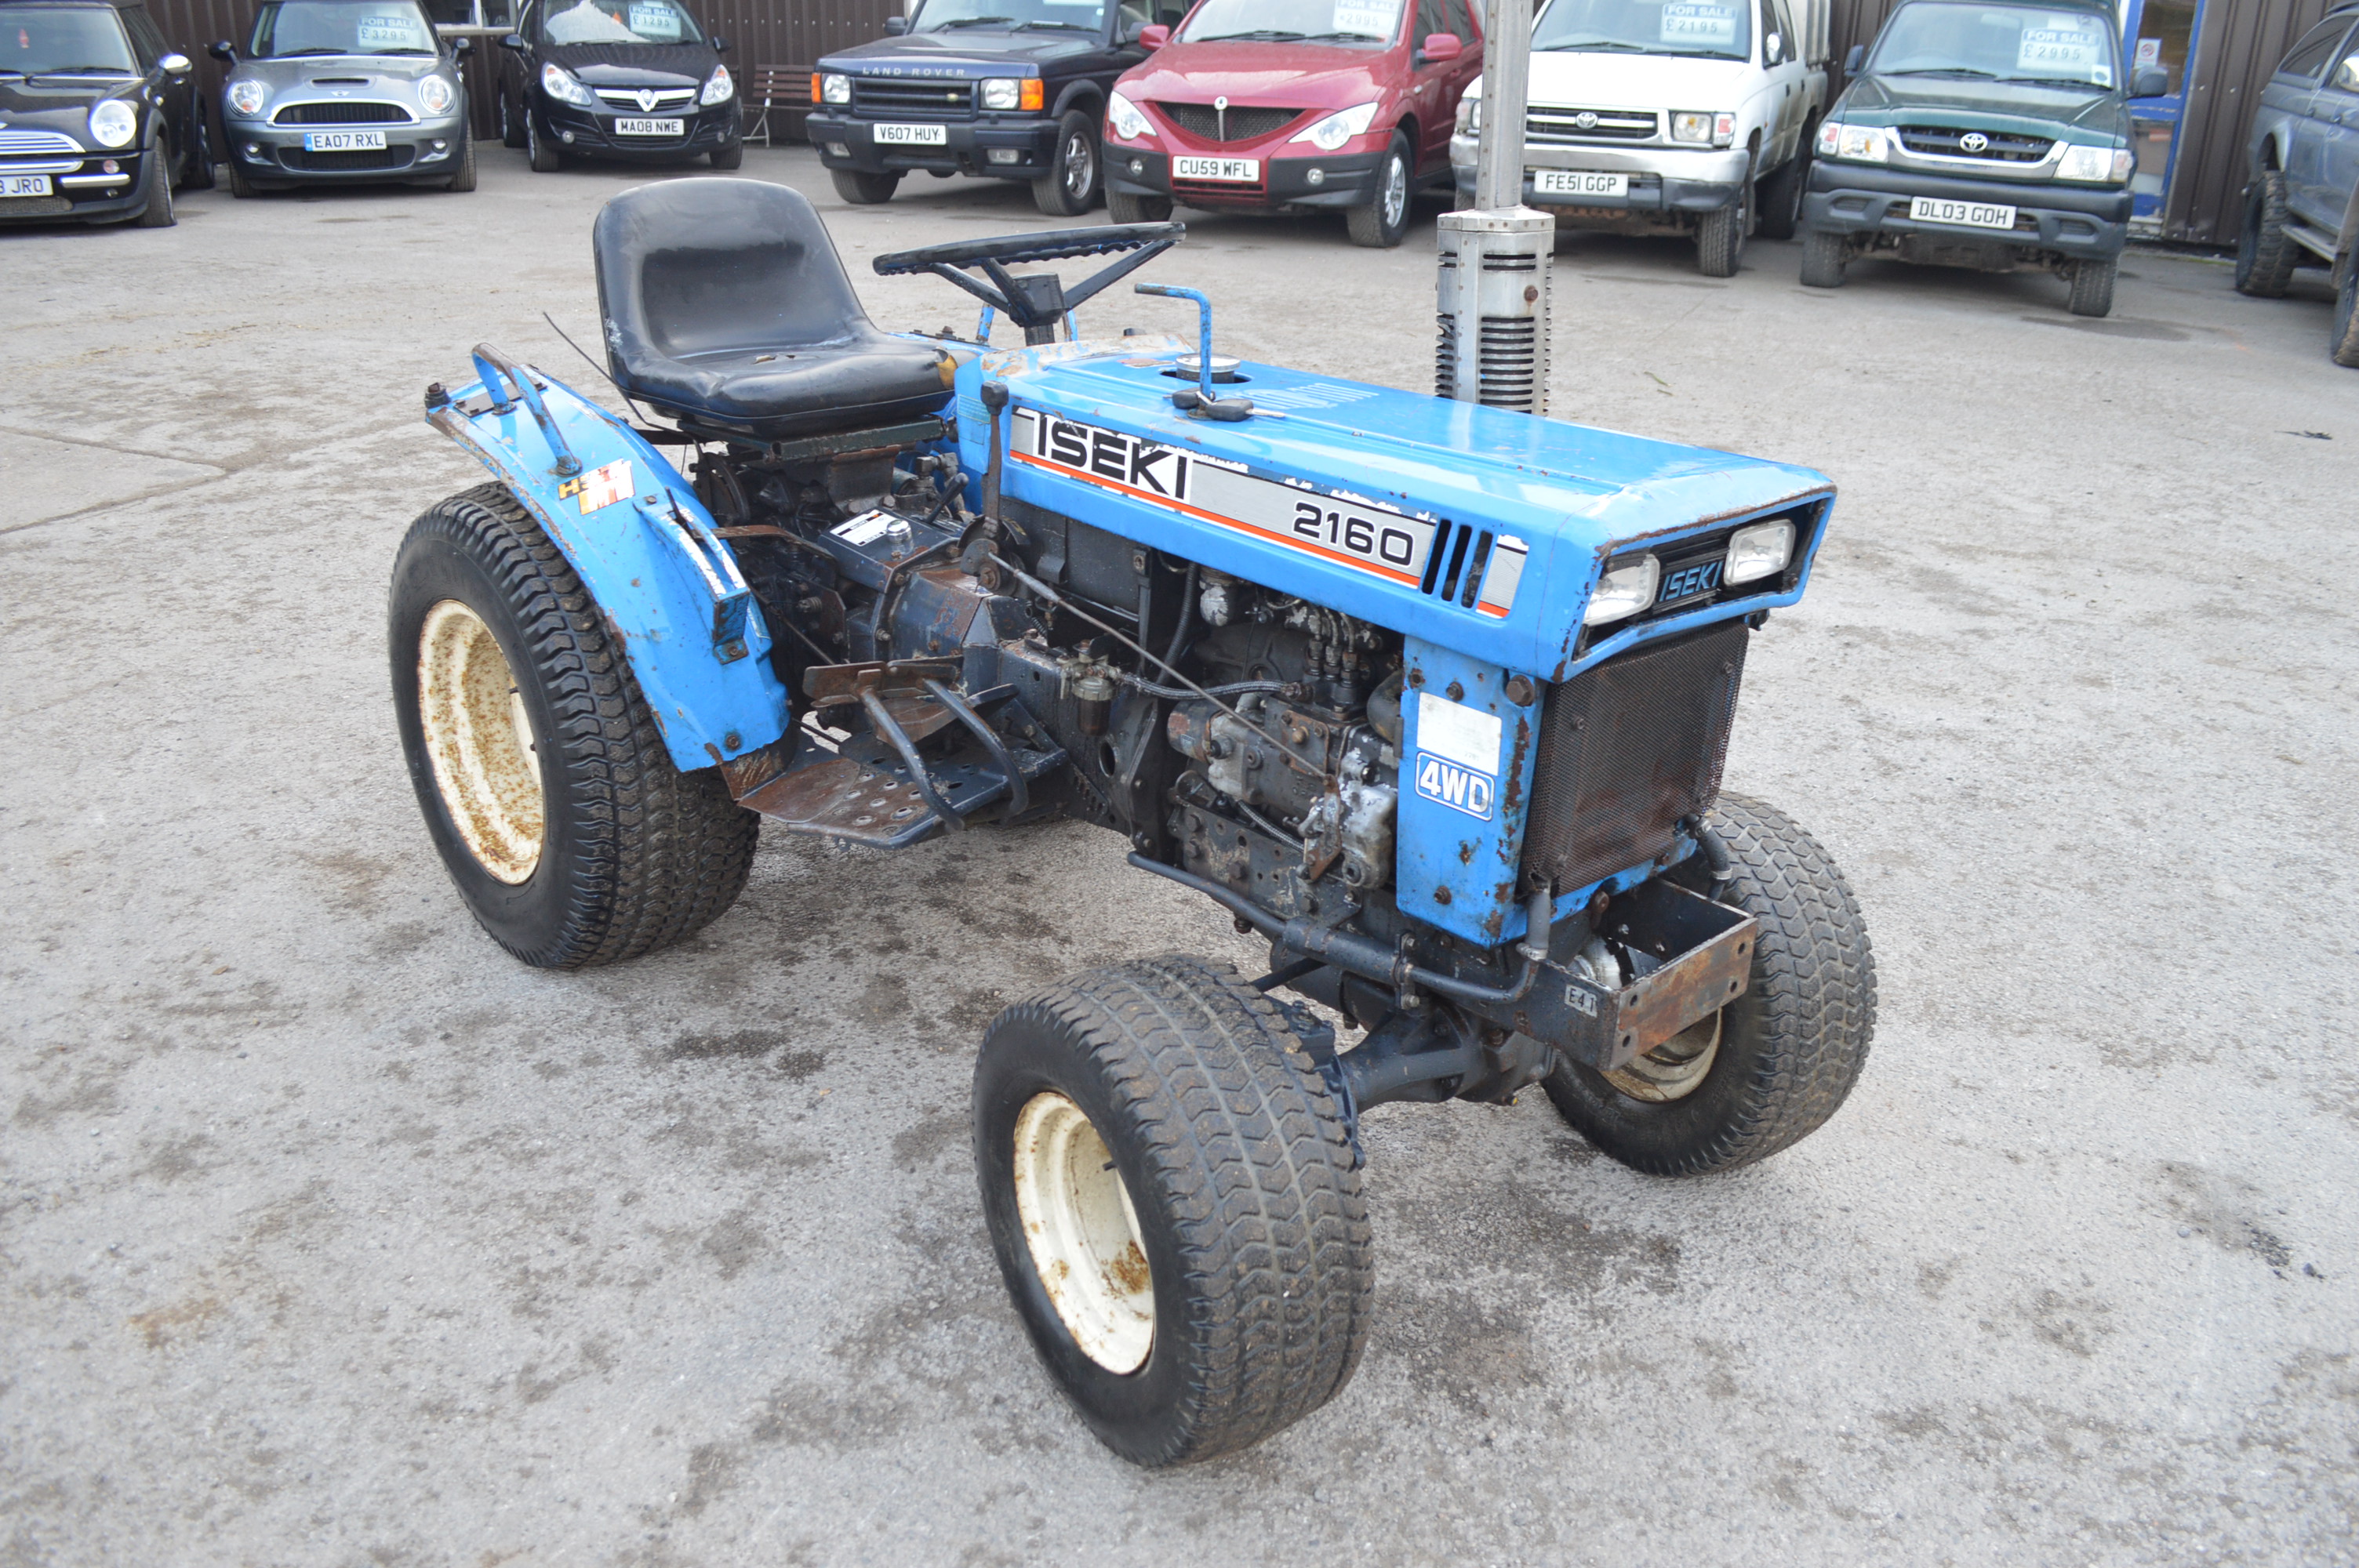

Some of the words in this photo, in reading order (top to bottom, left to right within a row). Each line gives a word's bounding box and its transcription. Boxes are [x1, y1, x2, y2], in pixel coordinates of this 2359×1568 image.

[633, 5, 652, 14] FOR
[653, 8, 677, 16] SALE
[1668, 5, 1696, 16] FOR
[1699, 6, 1732, 18] SALE
[362, 17, 385, 27] FOR
[2026, 31, 2057, 42] FOR
[2059, 32, 2095, 45] SALE
[863, 67, 902, 76] LAND
[911, 67, 965, 77] ROVER
[620, 121, 652, 132] MA08
[656, 121, 678, 132] NWE
[880, 125, 911, 140] V607
[914, 127, 940, 141] HUY
[314, 134, 351, 148] EA07
[355, 133, 383, 147] RXL
[1180, 159, 1219, 176] CU59
[1223, 161, 1252, 177] WFL
[11, 178, 45, 194] JRO
[1546, 174, 1582, 191] FE51
[1586, 176, 1617, 192] GGP
[1918, 201, 1967, 220] DL03
[1971, 206, 2008, 225] GOH
[1038, 413, 1188, 500] ISEKI
[1293, 500, 1414, 567] 2160
[1659, 560, 1725, 602] ISEKI
[1419, 760, 1490, 814] 4WD
